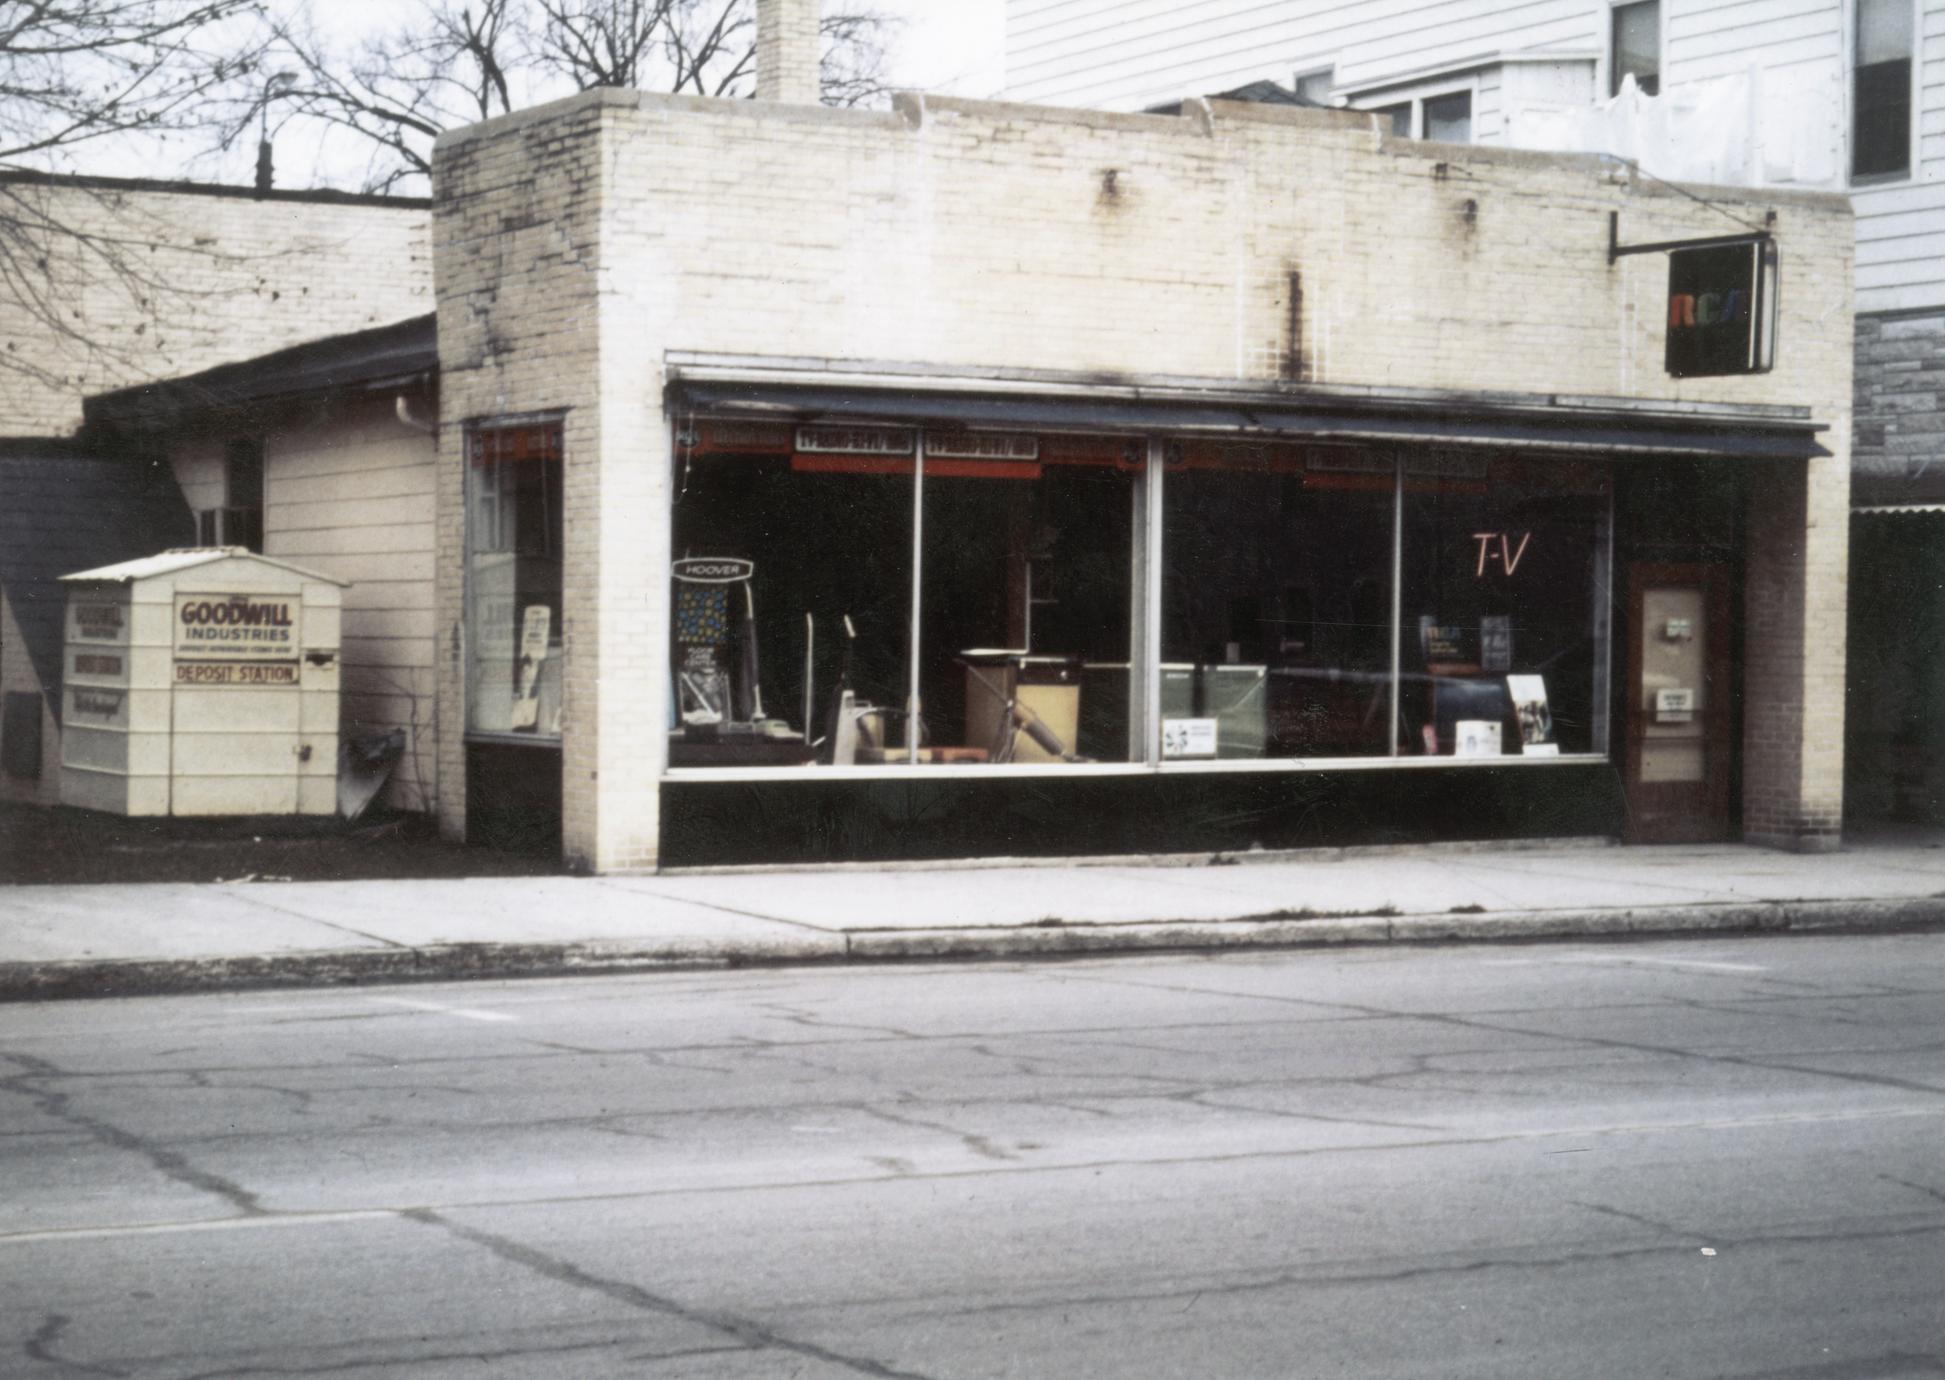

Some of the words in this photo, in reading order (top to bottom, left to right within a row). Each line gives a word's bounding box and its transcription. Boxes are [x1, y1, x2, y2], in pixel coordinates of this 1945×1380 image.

[686, 564, 739, 576] HOOVER
[181, 601, 293, 626] GOODWILL
[186, 627, 290, 641] INDUSTRIES
[176, 665, 233, 682] DEPOSIT
[240, 666, 293, 682] STATION
